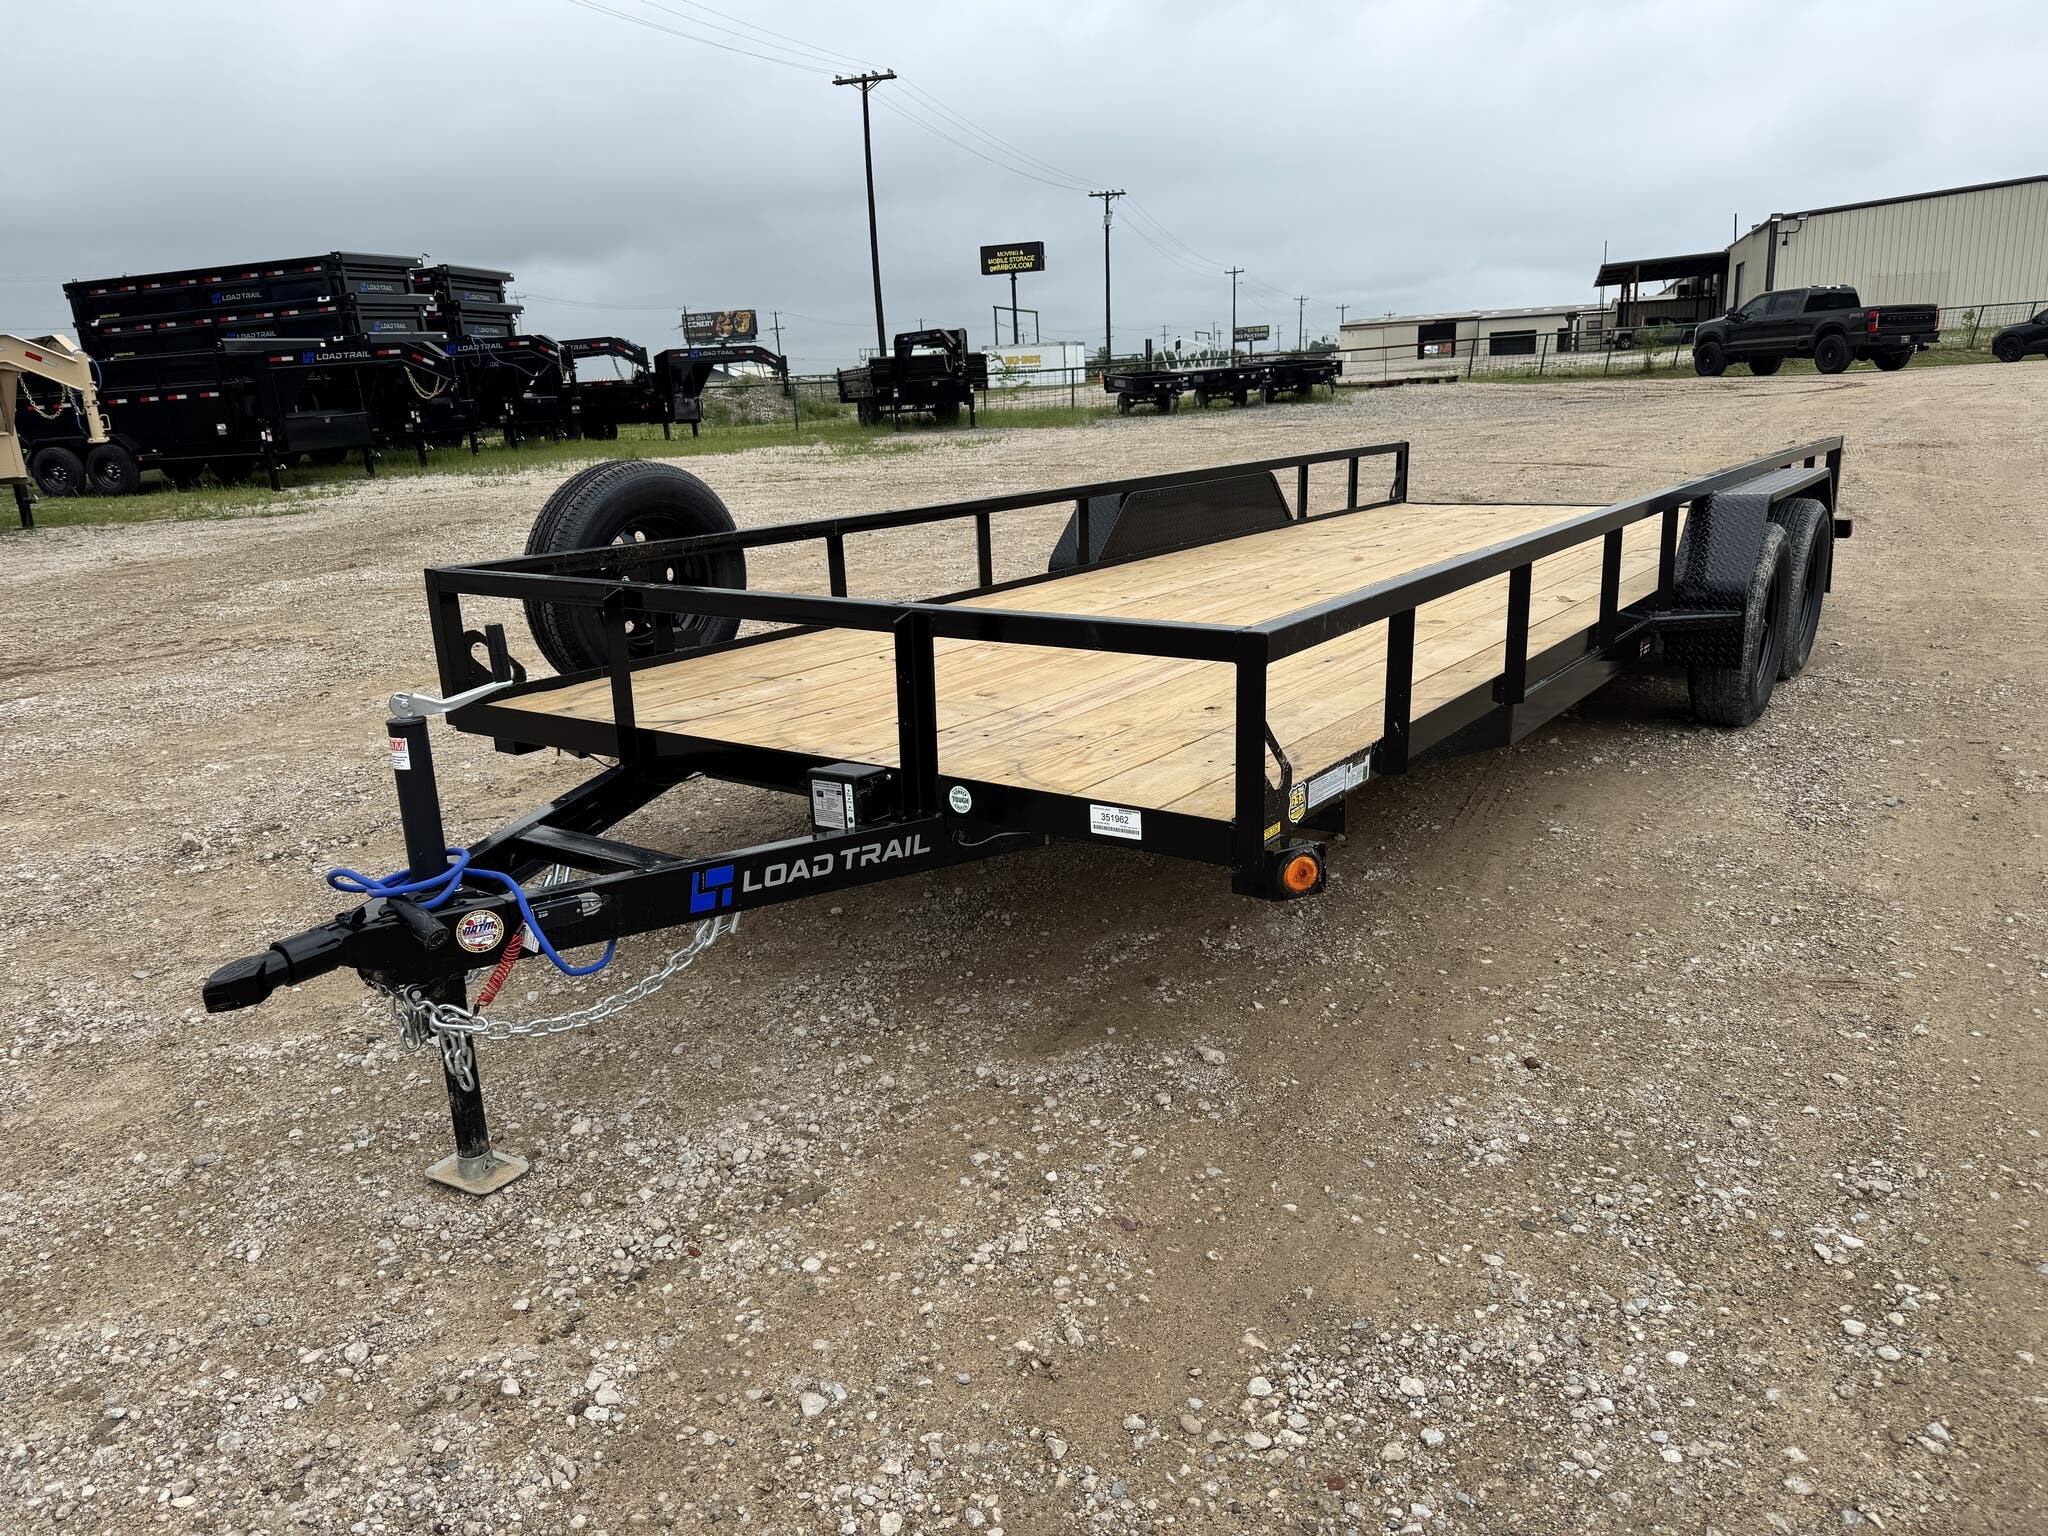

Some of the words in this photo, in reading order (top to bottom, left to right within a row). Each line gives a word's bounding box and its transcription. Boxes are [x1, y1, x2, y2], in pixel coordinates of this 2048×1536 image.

[988, 257, 1009, 265] MOBILE
[1009, 255, 1036, 263] STORAGE
[222, 293, 241, 302] LOAD
[241, 291, 262, 299] TRAIL
[256, 330, 277, 338] TRAIL
[457, 344, 479, 352] LOAD
[480, 342, 503, 350] TRAIL
[316, 352, 342, 361] LOAD
[342, 350, 371, 359] TRAIL
[742, 853, 834, 893] LOAD
[840, 833, 931, 870] TRAIL
